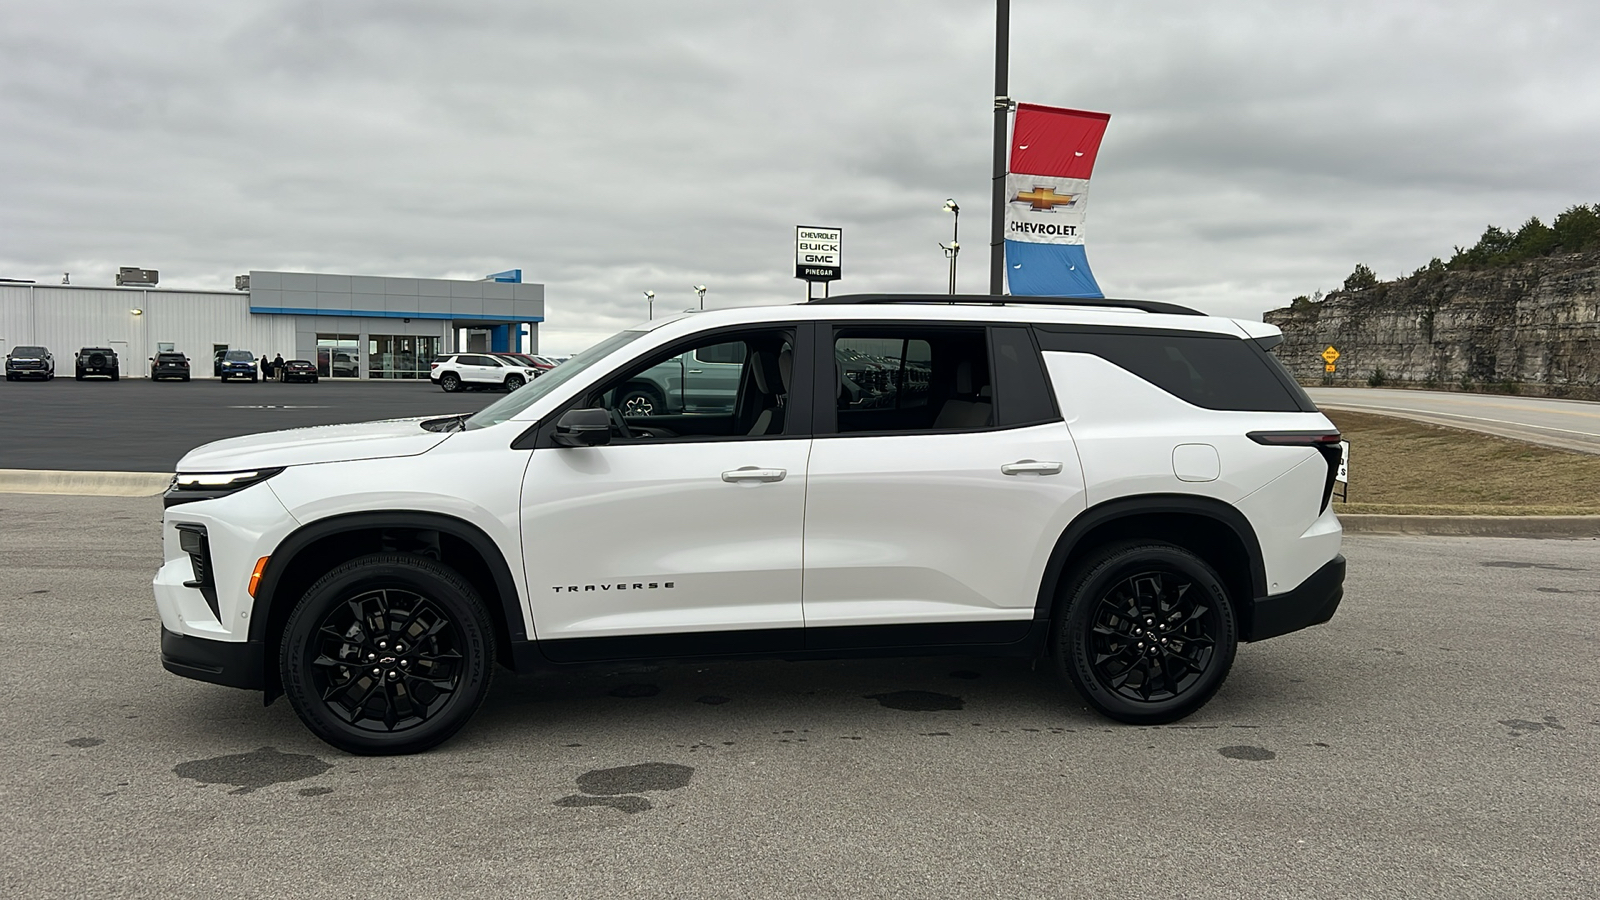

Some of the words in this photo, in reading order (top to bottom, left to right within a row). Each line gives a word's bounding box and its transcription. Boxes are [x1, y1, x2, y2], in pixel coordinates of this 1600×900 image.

[800, 231, 838, 240] CHEVROLET
[799, 243, 838, 252] BUICK
[805, 254, 833, 263] GMC
[805, 268, 833, 276] PINEGAR
[552, 582, 675, 593] TRAVERSE
